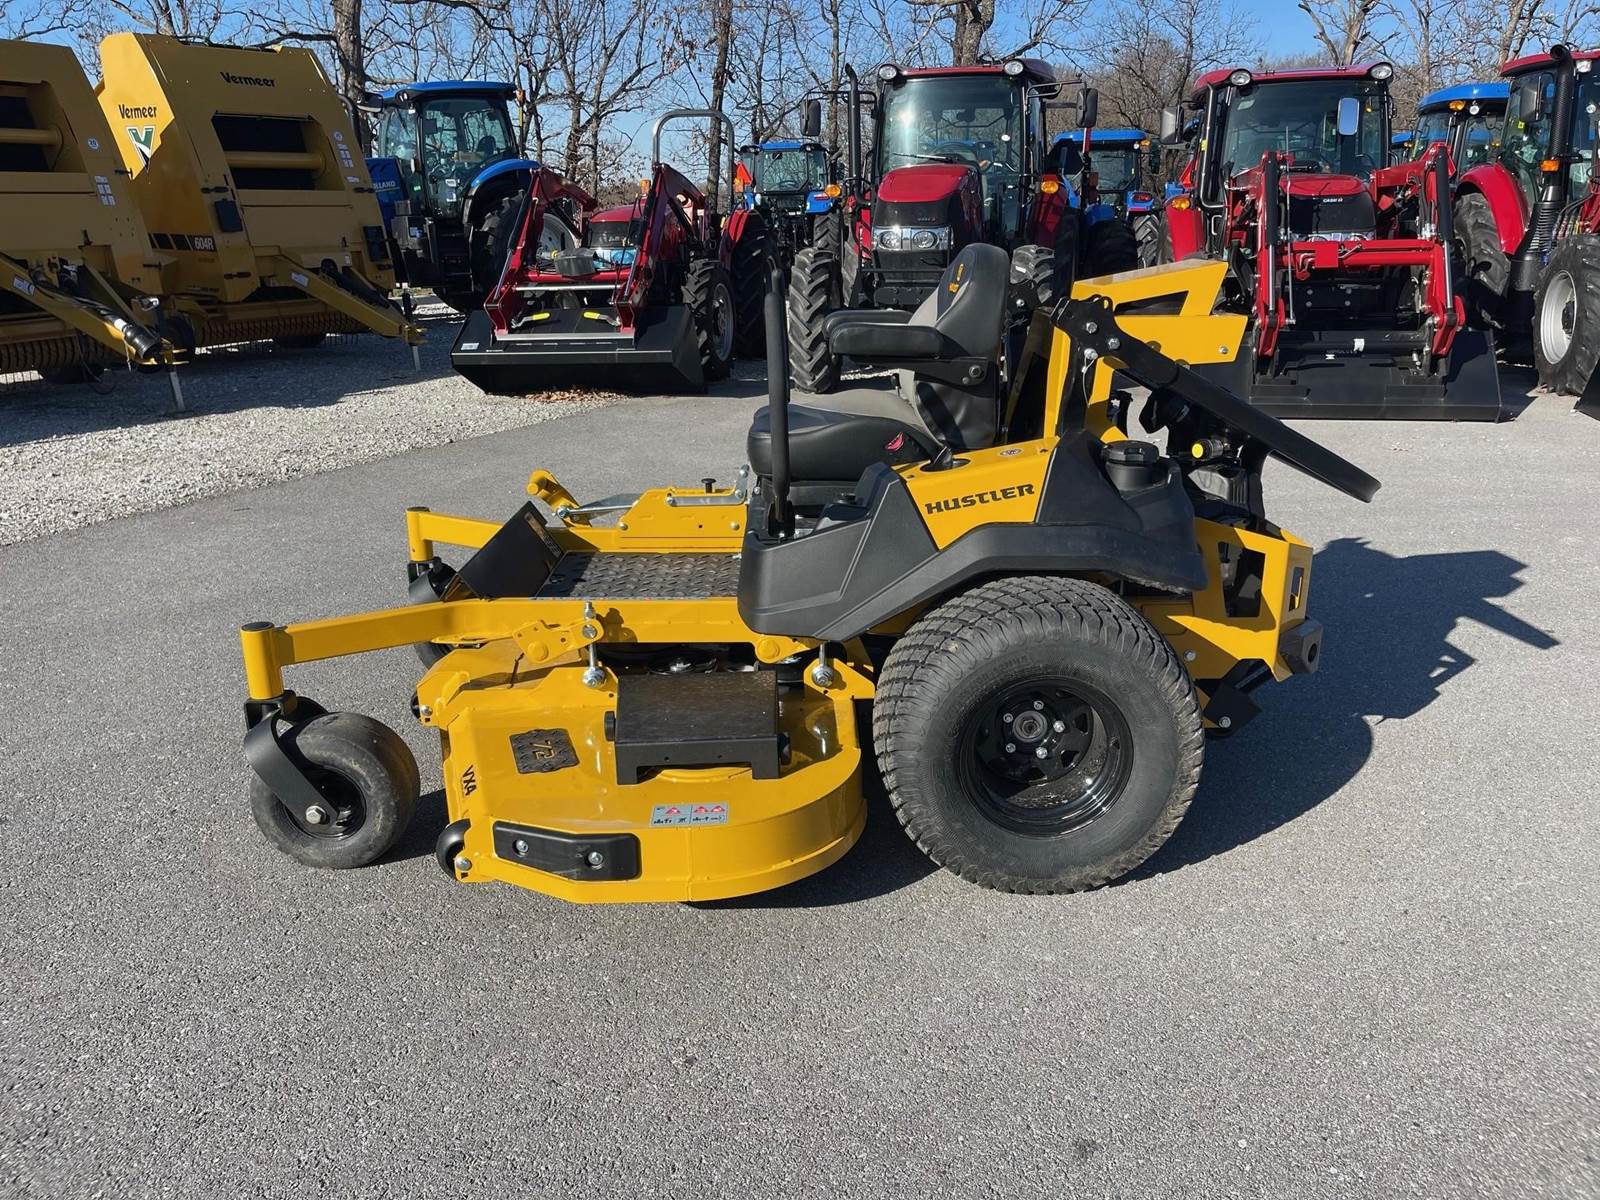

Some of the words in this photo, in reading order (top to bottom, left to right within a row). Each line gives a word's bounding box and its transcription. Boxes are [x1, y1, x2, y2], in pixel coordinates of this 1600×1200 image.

[220, 71, 276, 87] Vermeer
[118, 104, 157, 119] Vermeer
[194, 236, 215, 251] 604R
[924, 483, 1035, 515] HUSTLER
[530, 740, 556, 760] 72
[462, 764, 477, 796] VX4
